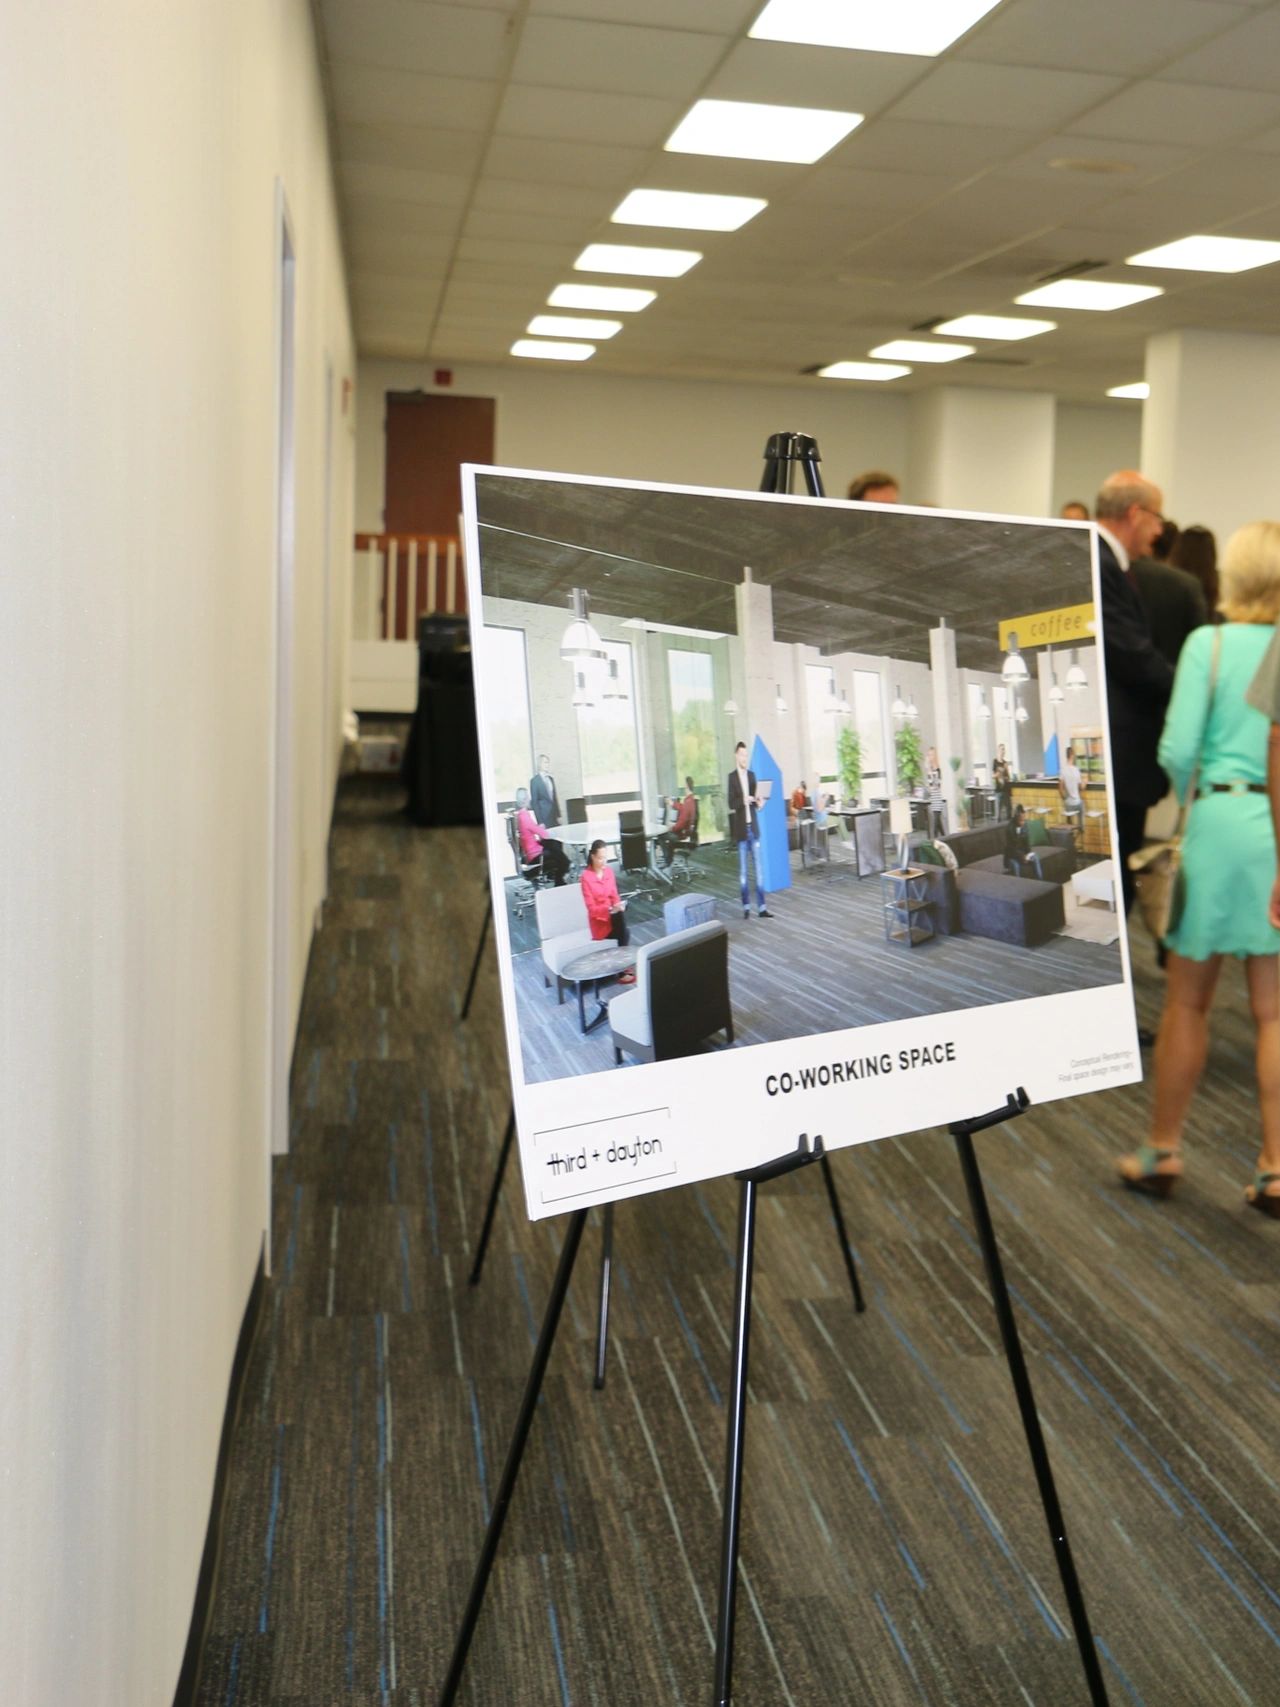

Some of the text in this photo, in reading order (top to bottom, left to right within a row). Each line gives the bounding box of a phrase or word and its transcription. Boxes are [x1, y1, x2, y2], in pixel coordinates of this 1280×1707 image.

[1031, 615, 1082, 637] coffee
[766, 1042, 956, 1096] CO-WORKING SPACE
[547, 1147, 587, 1176] third
[606, 1136, 663, 1166] dayton
